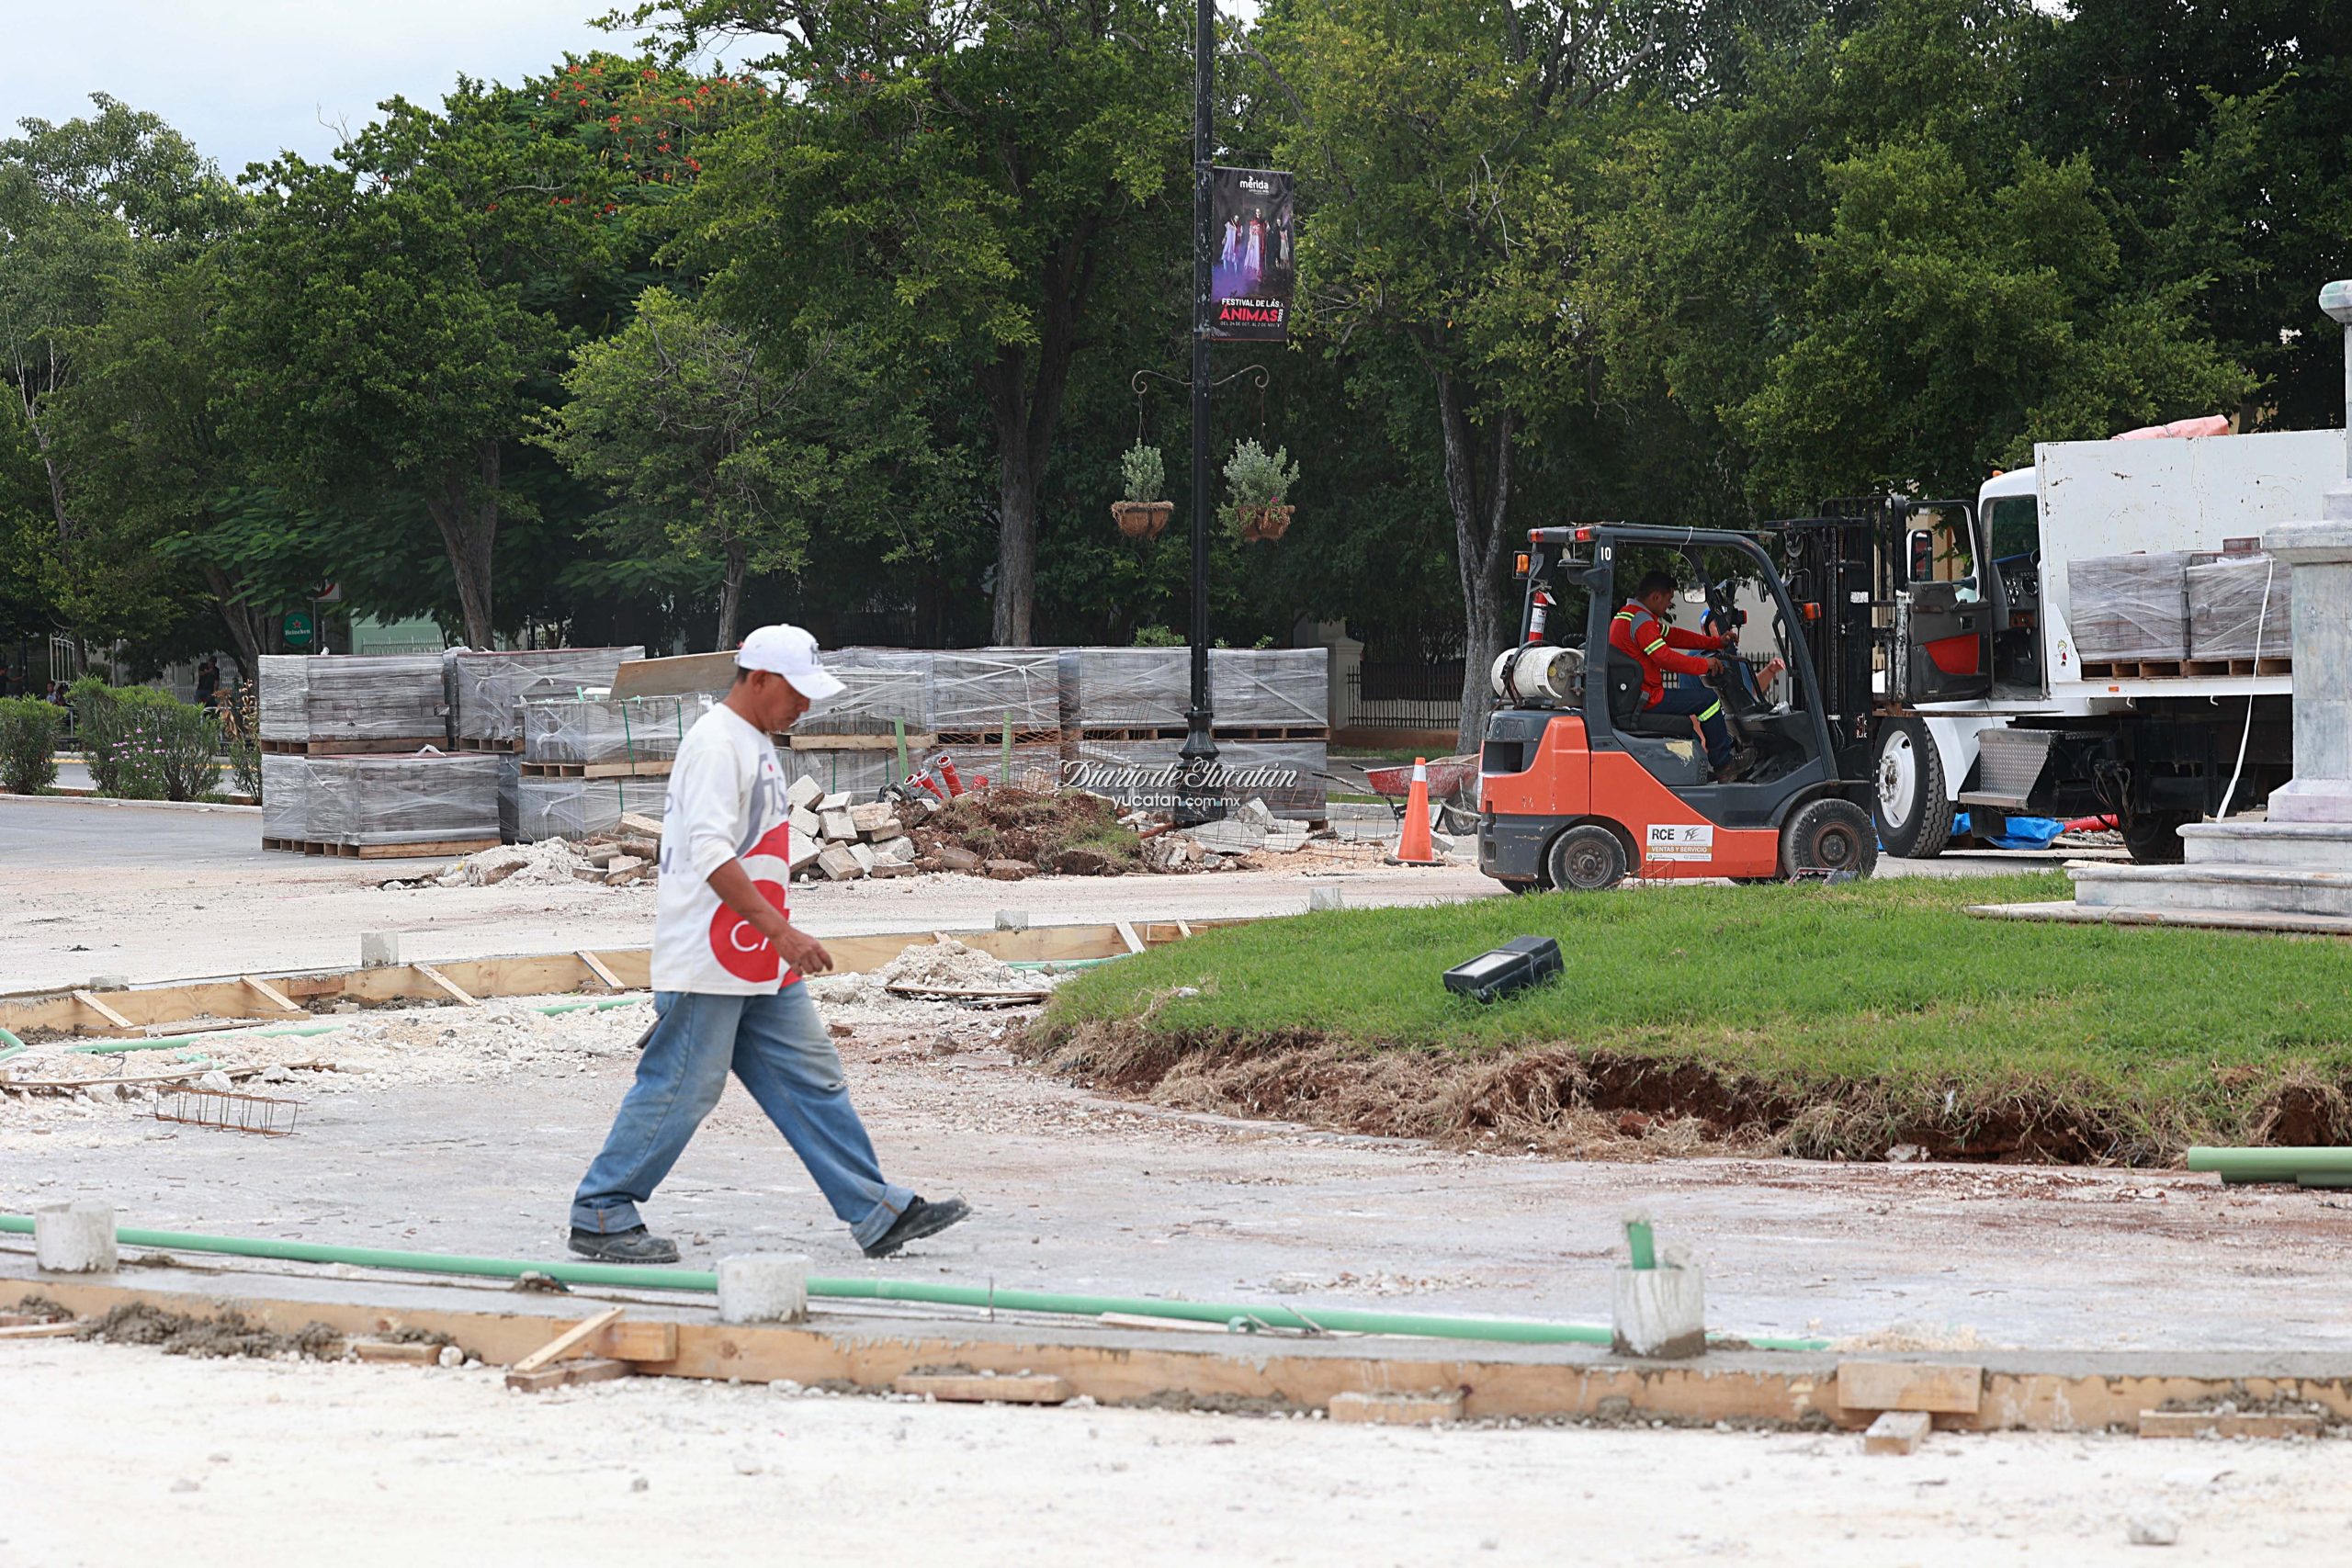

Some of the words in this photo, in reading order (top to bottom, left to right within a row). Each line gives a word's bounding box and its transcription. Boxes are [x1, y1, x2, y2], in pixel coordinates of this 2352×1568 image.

[1221, 298, 1254, 307] FESTIVAL
[1256, 299, 1265, 308] DE
[1219, 304, 1278, 321] ÁNIMAS
[1600, 547, 1611, 561] 10
[1651, 829, 1675, 840] RCE
